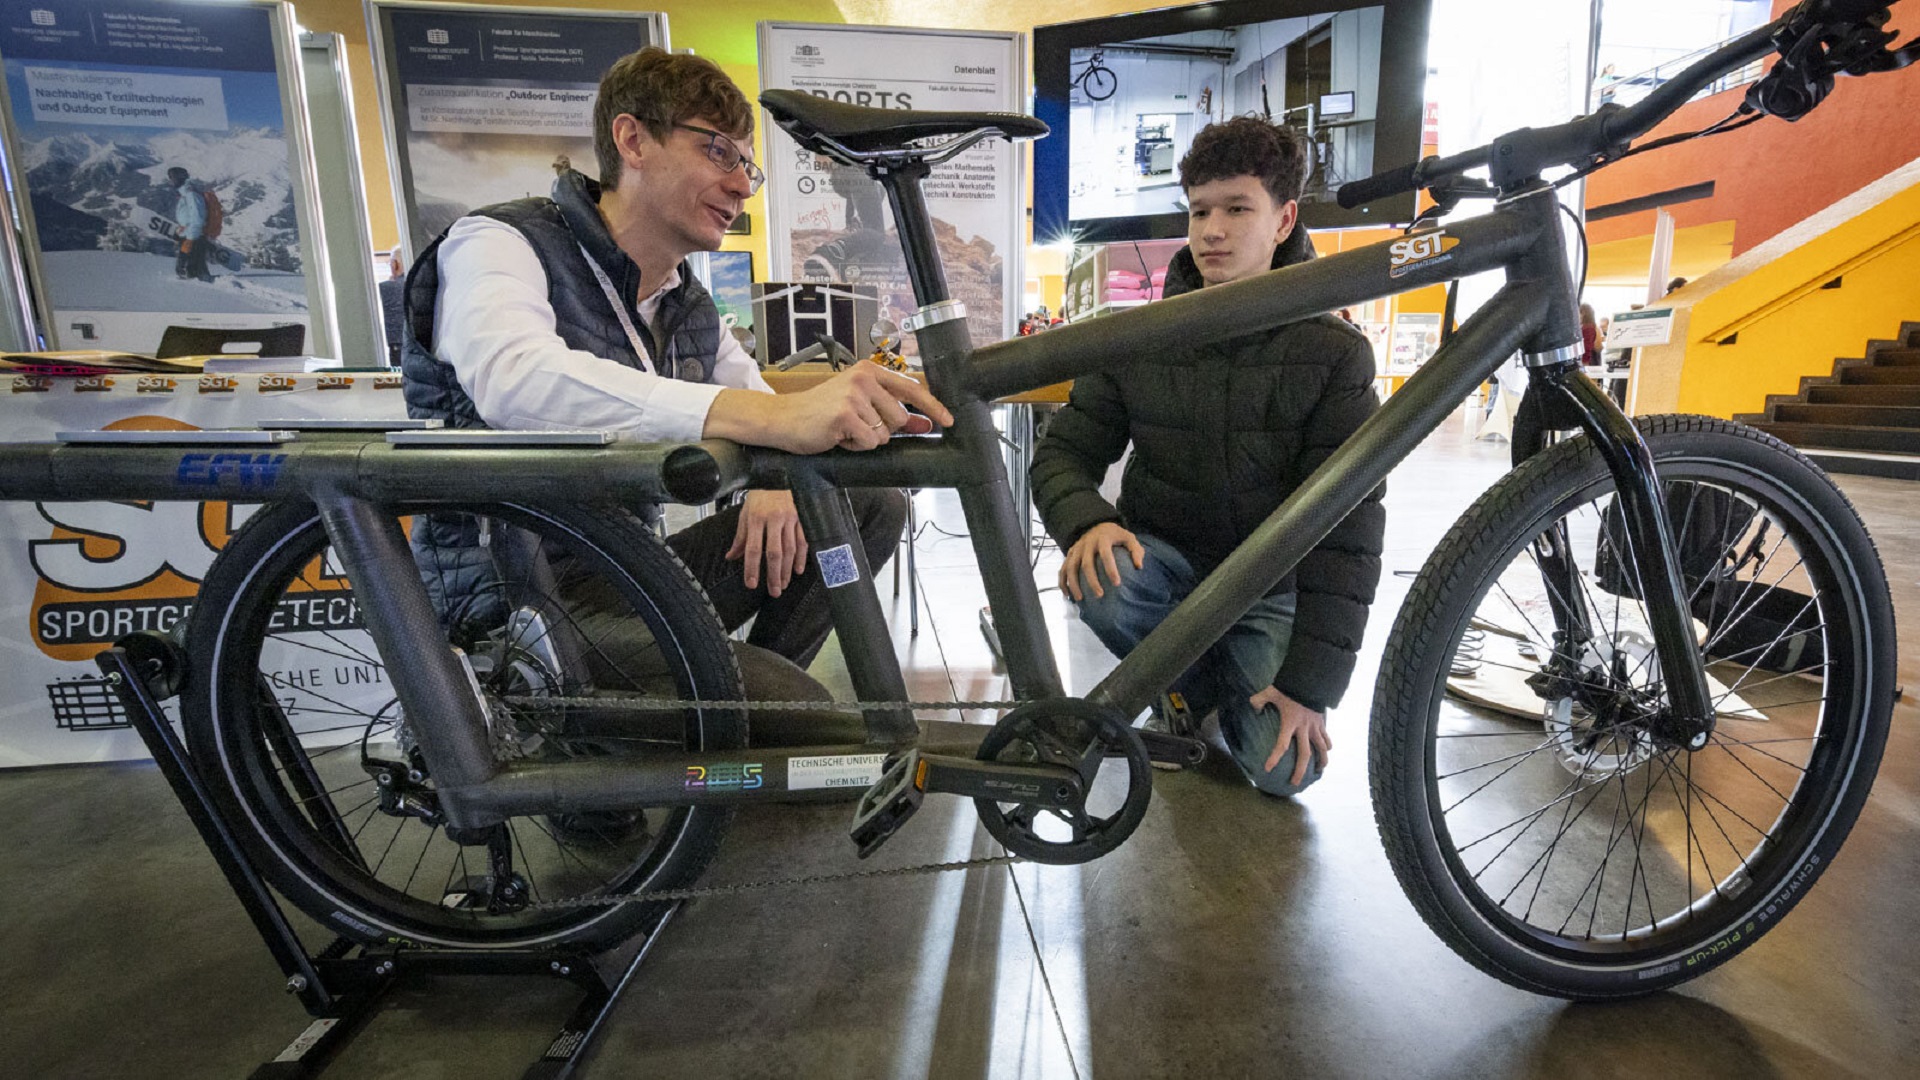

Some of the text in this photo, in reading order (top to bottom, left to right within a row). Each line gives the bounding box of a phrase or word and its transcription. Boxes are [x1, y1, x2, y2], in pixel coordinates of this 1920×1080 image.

[954, 65, 996, 75] Datenblatt
[31, 71, 134, 87] Masterstudiengang
[35, 88, 205, 107] Nachhaltige Textiltechnologien
[38, 103, 168, 117] und Outdoor Equipment
[955, 163, 996, 173] Mathematik
[963, 173, 996, 181] Anatomie
[958, 182, 996, 191] Werkstoffe
[952, 191, 996, 200] Konstruktion
[1389, 229, 1446, 266] SGT
[76, 377, 106, 388] SGT
[138, 376, 169, 388] SGT
[200, 376, 229, 388] SGT
[260, 375, 289, 388] SGT
[318, 375, 345, 385] SGT
[791, 755, 888, 769] TECHNISCHE UNIVERS
[825, 776, 870, 788] CHEMNITZ
[1758, 853, 1821, 923] SCHWALBE
[1686, 931, 1742, 967] PICK-UP
